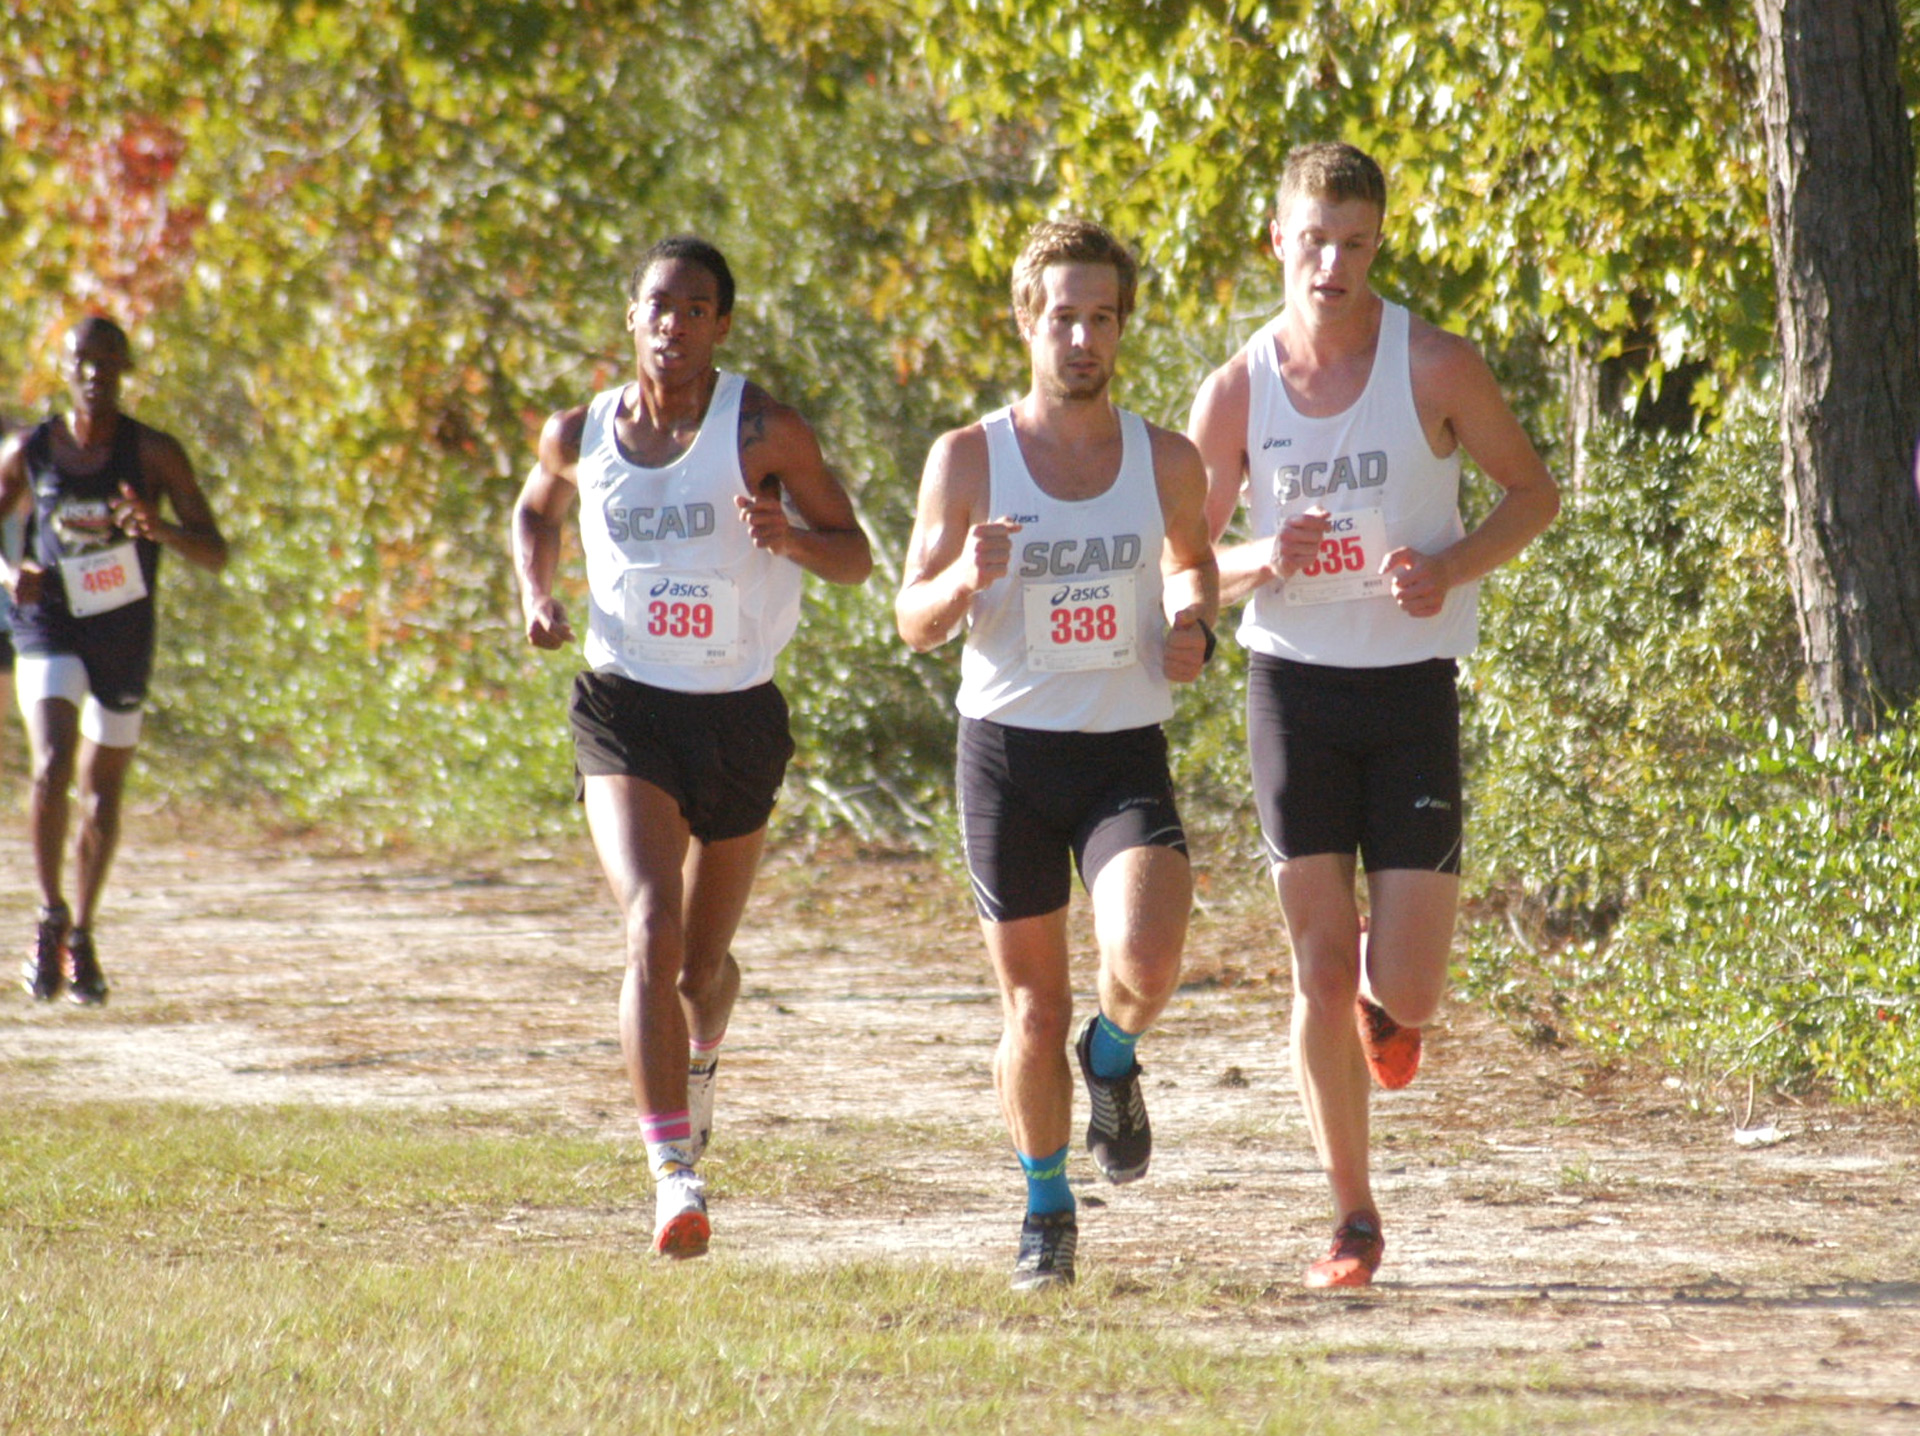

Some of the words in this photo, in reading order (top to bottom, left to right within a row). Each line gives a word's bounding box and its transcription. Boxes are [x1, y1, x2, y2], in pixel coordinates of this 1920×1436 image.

[1277, 450, 1388, 501] SCAD
[608, 502, 715, 543] SCAD
[1020, 533, 1142, 578] SCAD
[647, 600, 714, 639] 339
[1050, 604, 1117, 645] 338
